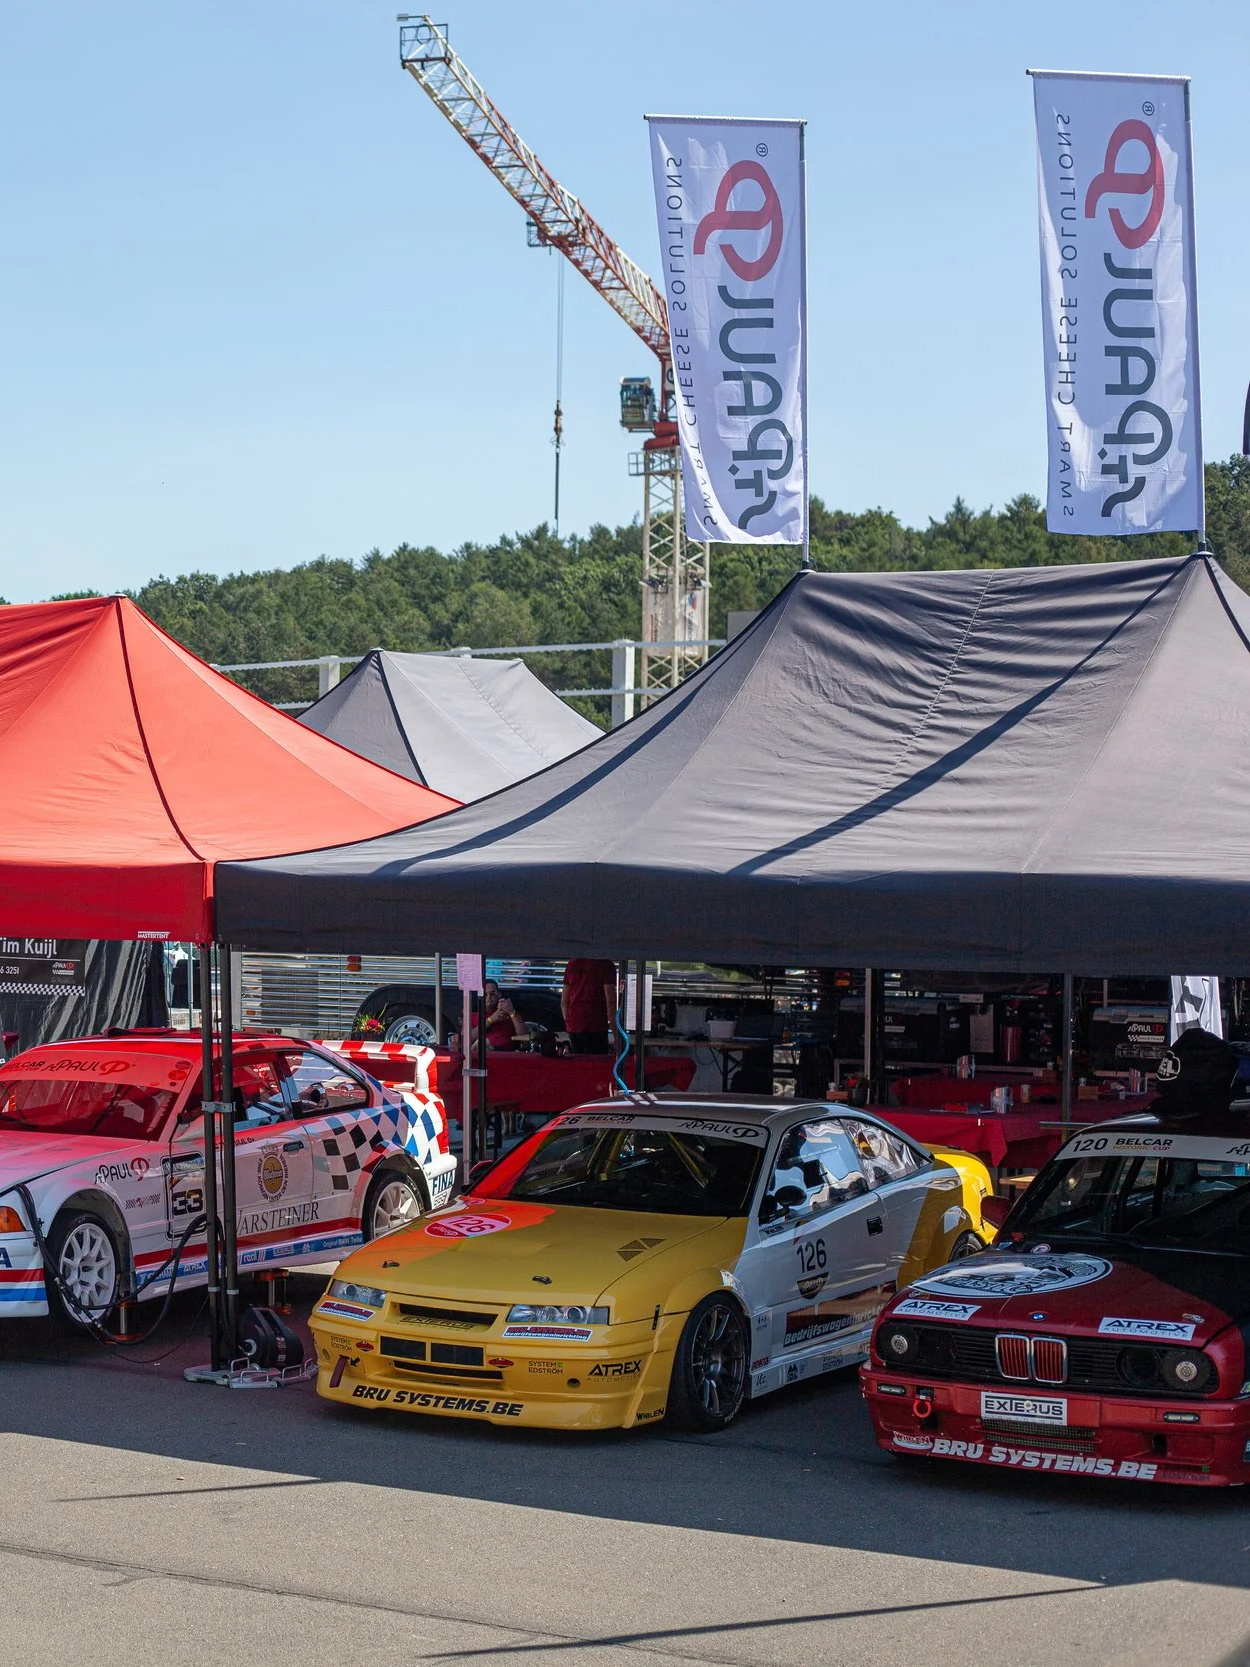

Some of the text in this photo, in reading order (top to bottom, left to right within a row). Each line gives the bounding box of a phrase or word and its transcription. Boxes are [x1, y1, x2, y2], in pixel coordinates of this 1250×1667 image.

[24, 938, 58, 959] Kuijl
[1072, 1138, 1109, 1152] 120
[1115, 1138, 1174, 1147] BELCAR
[432, 1170, 453, 1196] FINA
[173, 1188, 203, 1216] 33
[448, 1216, 496, 1233] 126
[796, 1238, 827, 1274] 126
[897, 1308, 968, 1319] AUTOMOTIVE
[901, 1300, 976, 1314] ATREX
[1102, 1327, 1189, 1338] AUTOMOTIVE
[1104, 1319, 1191, 1334] ATREX
[528, 1366, 564, 1375] EDSTRÖM
[588, 1359, 642, 1376] ATREX
[352, 1384, 524, 1417] BRU SYSTEMS.BE
[984, 1399, 1063, 1416] EXTERUS
[893, 1431, 930, 1444] WHELEN
[931, 1438, 1158, 1480] BRU SYSTEMS.BE
